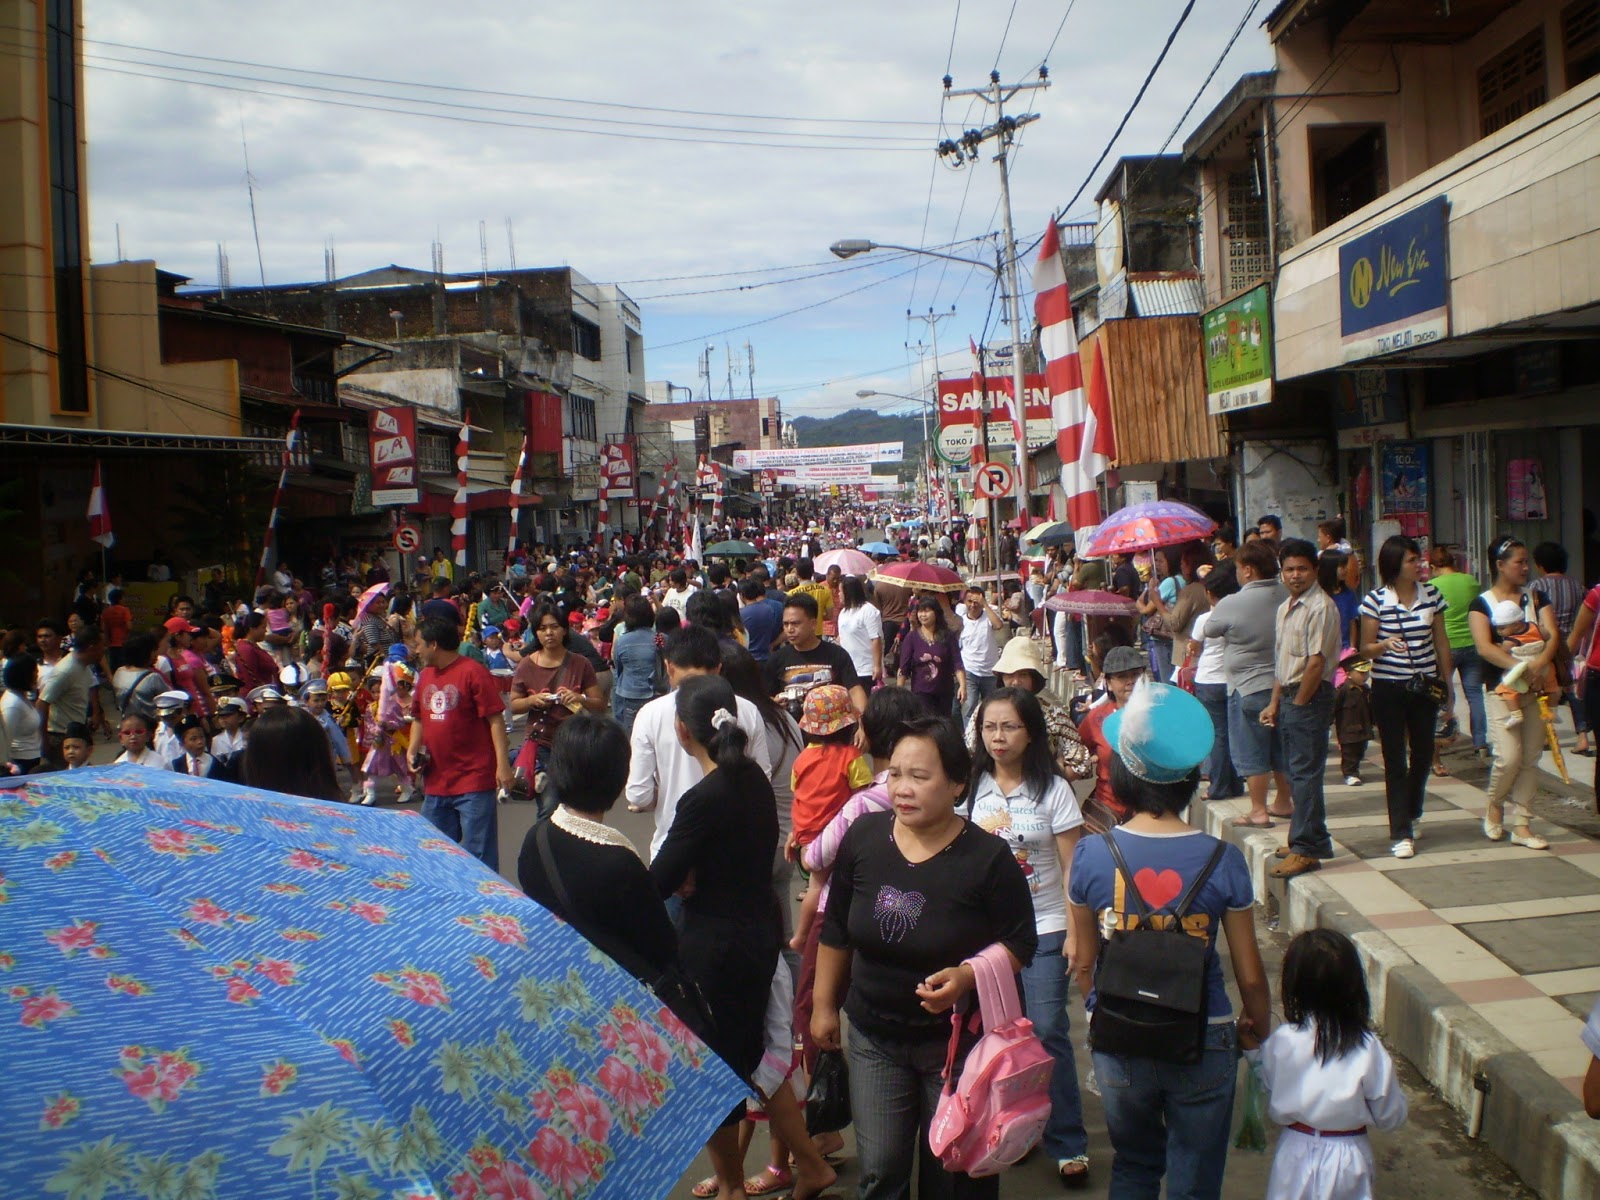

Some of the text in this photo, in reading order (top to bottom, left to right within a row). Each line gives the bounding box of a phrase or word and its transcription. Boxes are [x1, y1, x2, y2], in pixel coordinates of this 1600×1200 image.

[378, 415, 396, 428] LA
[945, 438, 968, 446] TOKO
[377, 437, 403, 462] LA
[610, 459, 626, 473] LA
[389, 466, 409, 481] LA
[988, 470, 1004, 492] P
